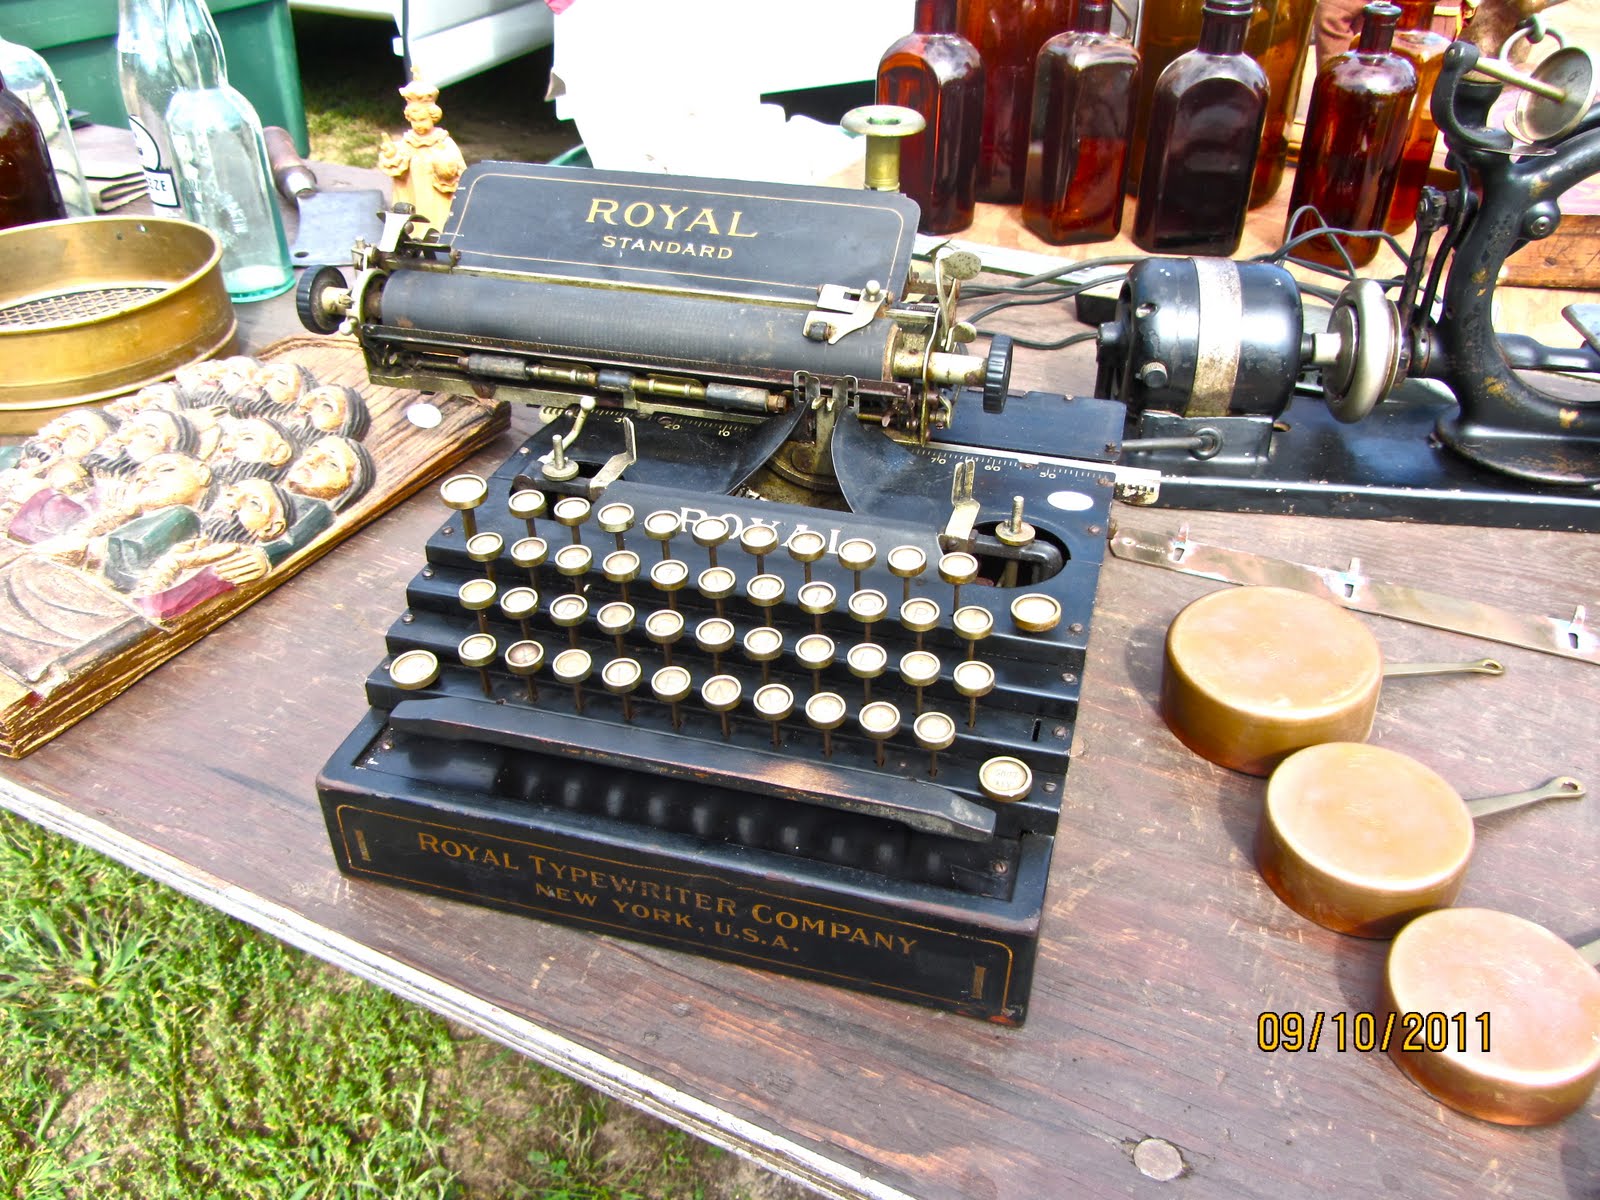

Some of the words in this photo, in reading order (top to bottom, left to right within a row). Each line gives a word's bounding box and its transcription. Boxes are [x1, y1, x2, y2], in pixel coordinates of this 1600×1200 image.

[585, 198, 758, 238] ROYAL
[602, 235, 733, 259] STANDARD
[417, 832, 520, 871] ROYAL
[528, 854, 737, 917] TYPEWRITER
[751, 904, 918, 955] COMPANY
[535, 882, 598, 908] NEW
[612, 899, 705, 933] YORK,
[714, 921, 800, 952] U.S.A.
